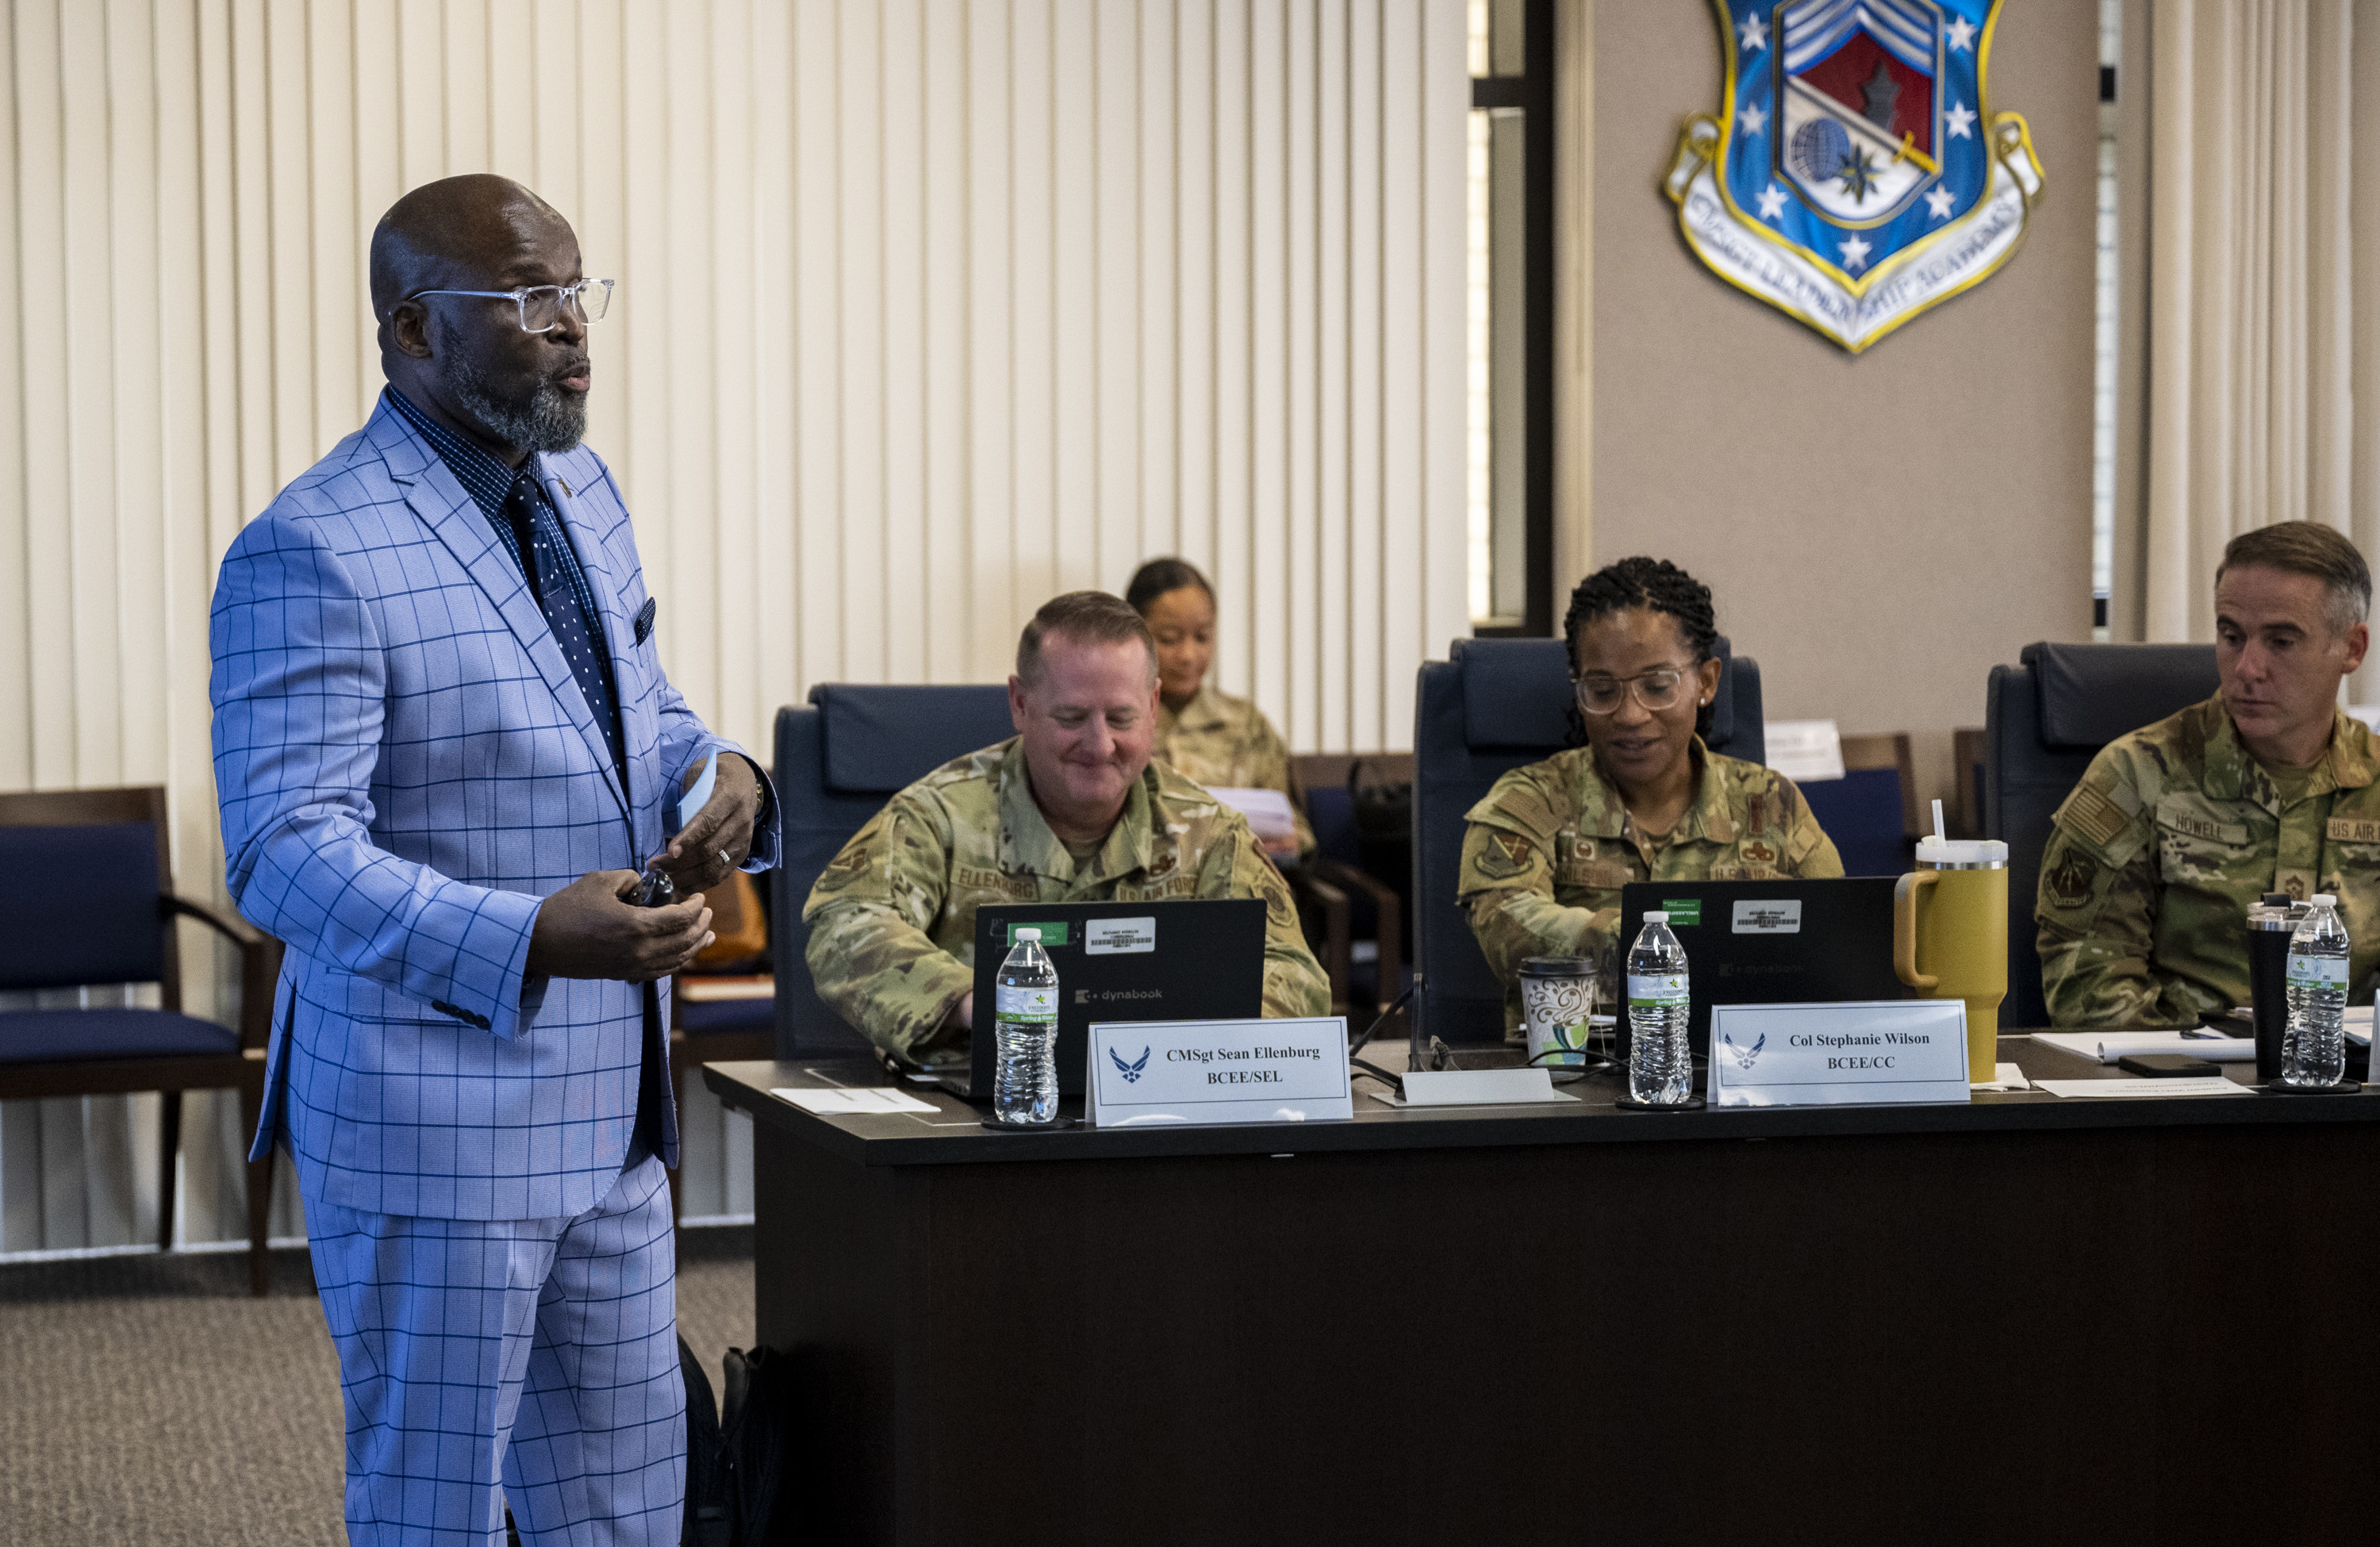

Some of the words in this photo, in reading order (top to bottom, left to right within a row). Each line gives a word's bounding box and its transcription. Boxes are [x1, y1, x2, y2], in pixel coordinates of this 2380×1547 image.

[2175, 814, 2222, 839] HOWELL
[2332, 820, 2349, 839] US
[2354, 823, 2375, 840] AIR
[1166, 877, 1196, 896] FORC
[1101, 989, 1162, 1001] dynabook
[1790, 1035, 1813, 1047] Col
[1816, 1034, 1881, 1049] Stephanie
[1884, 1032, 1930, 1045] Wilson
[1166, 1049, 1214, 1064] CMSgt
[1218, 1048, 1250, 1061] Sean
[1253, 1046, 1321, 1061] Ellenburg
[1828, 1056, 1895, 1069] BCEE/CC
[1207, 1070, 1284, 1084] BCEE/SEL
